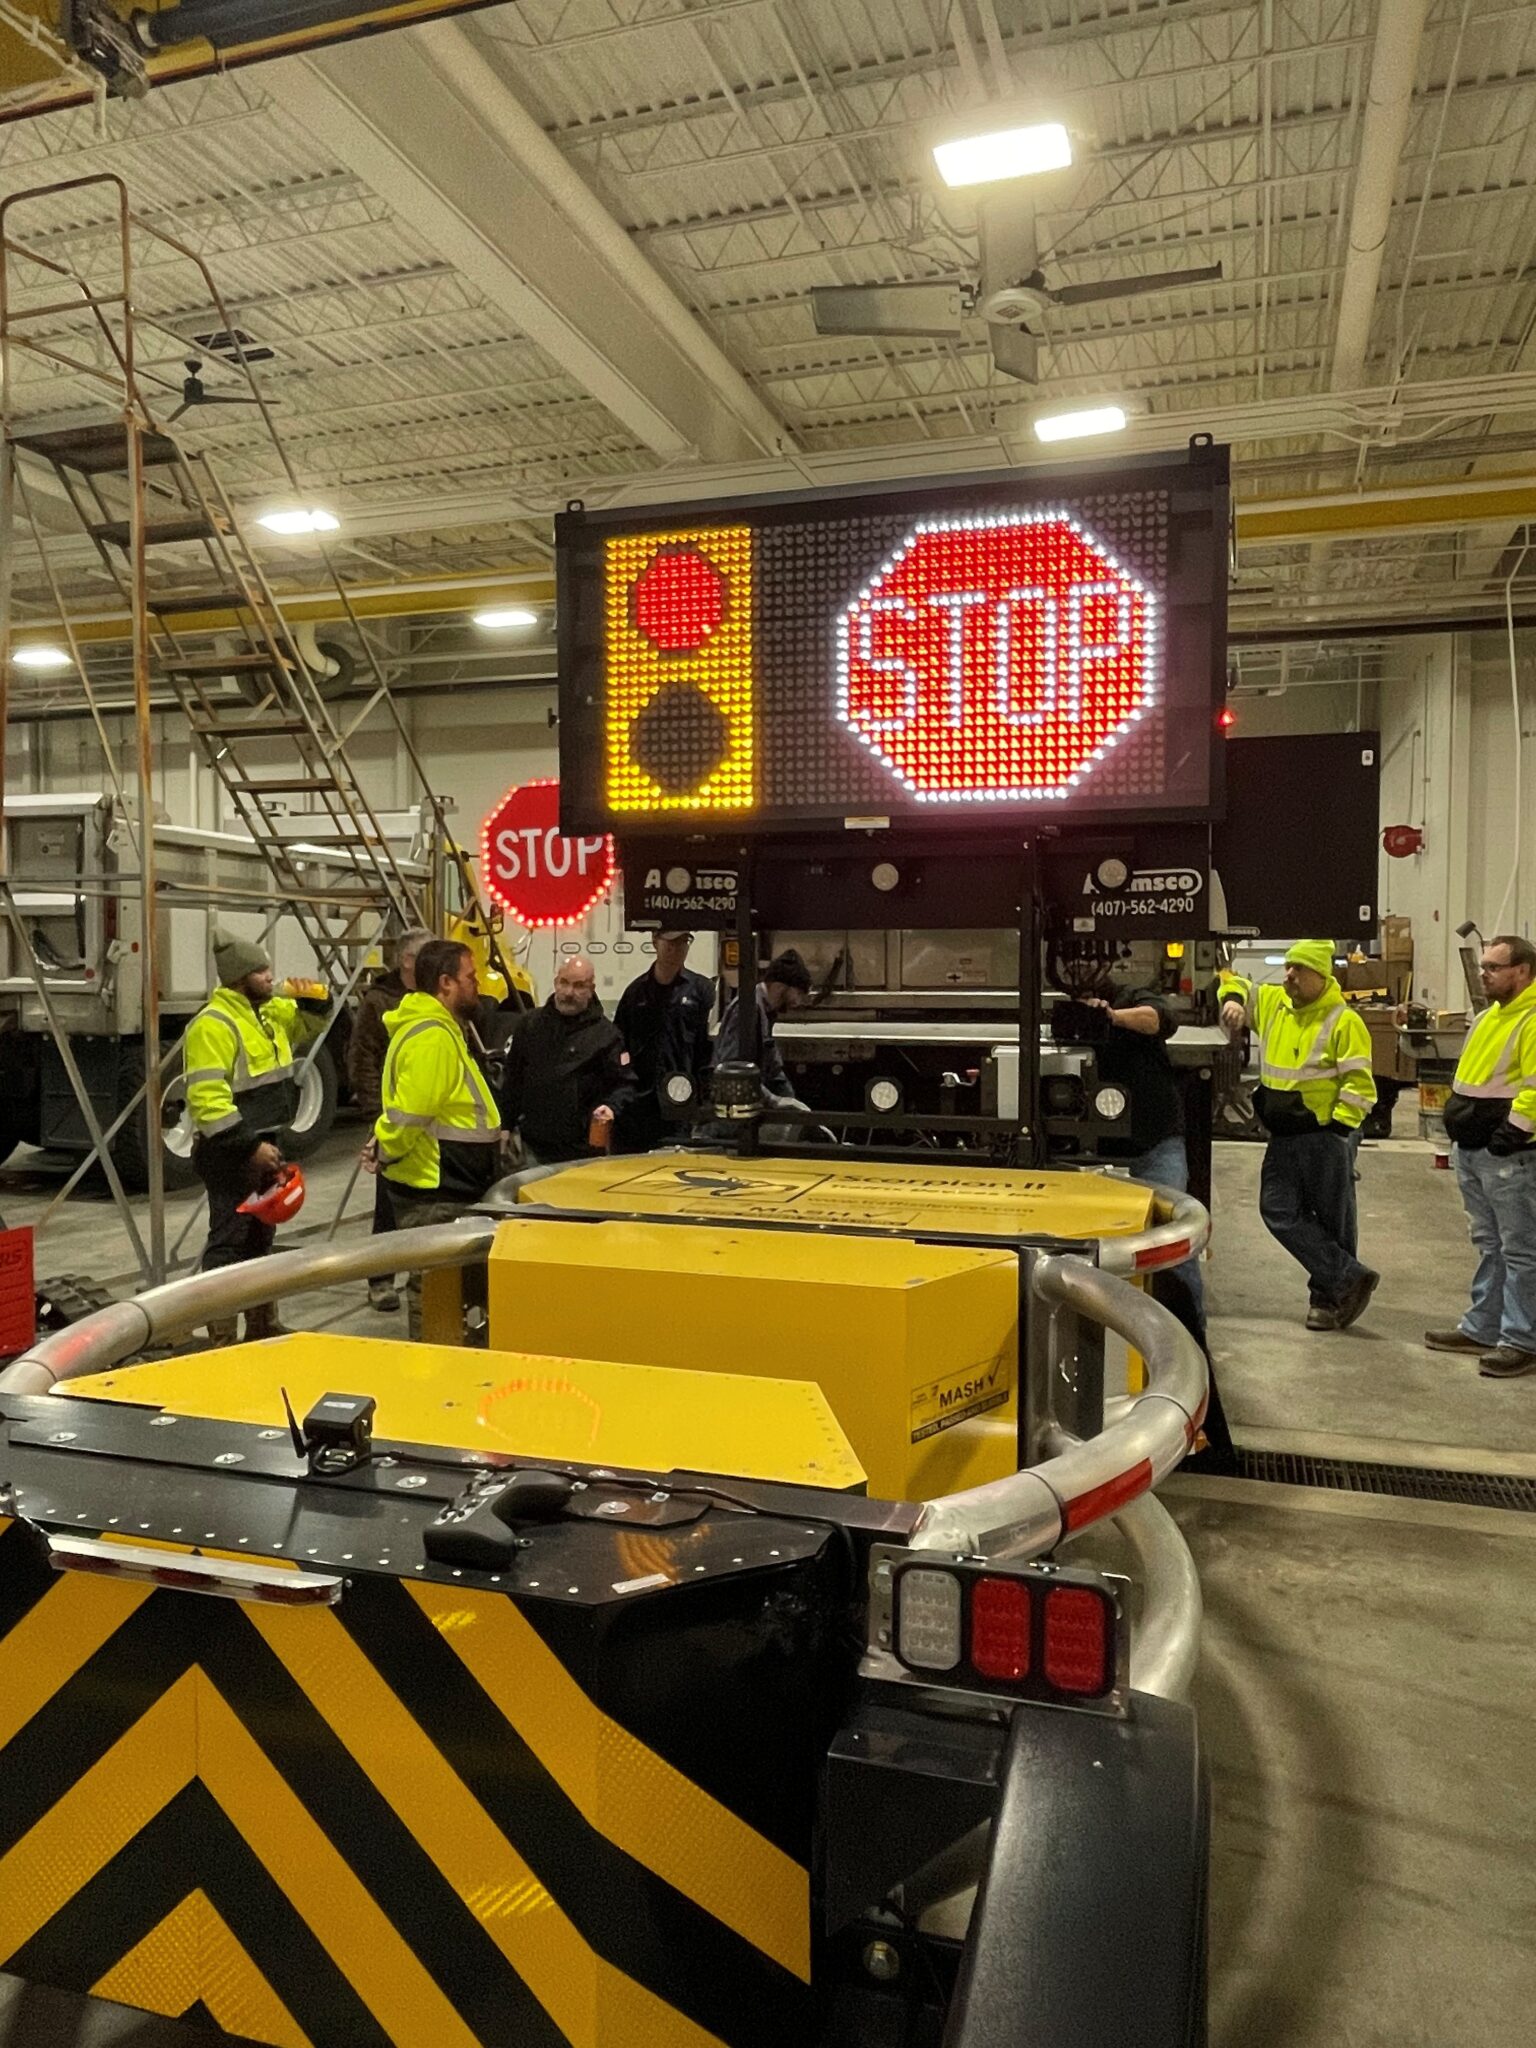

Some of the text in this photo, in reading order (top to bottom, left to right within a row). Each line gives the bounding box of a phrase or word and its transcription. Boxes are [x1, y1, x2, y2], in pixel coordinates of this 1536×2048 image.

[859, 583, 1131, 731] STOP
[496, 826, 603, 880] STOP
[1091, 897, 1195, 917] (407)-562-4290
[841, 1174, 1012, 1190] Scorpion
[939, 1377, 984, 1408] MASH
